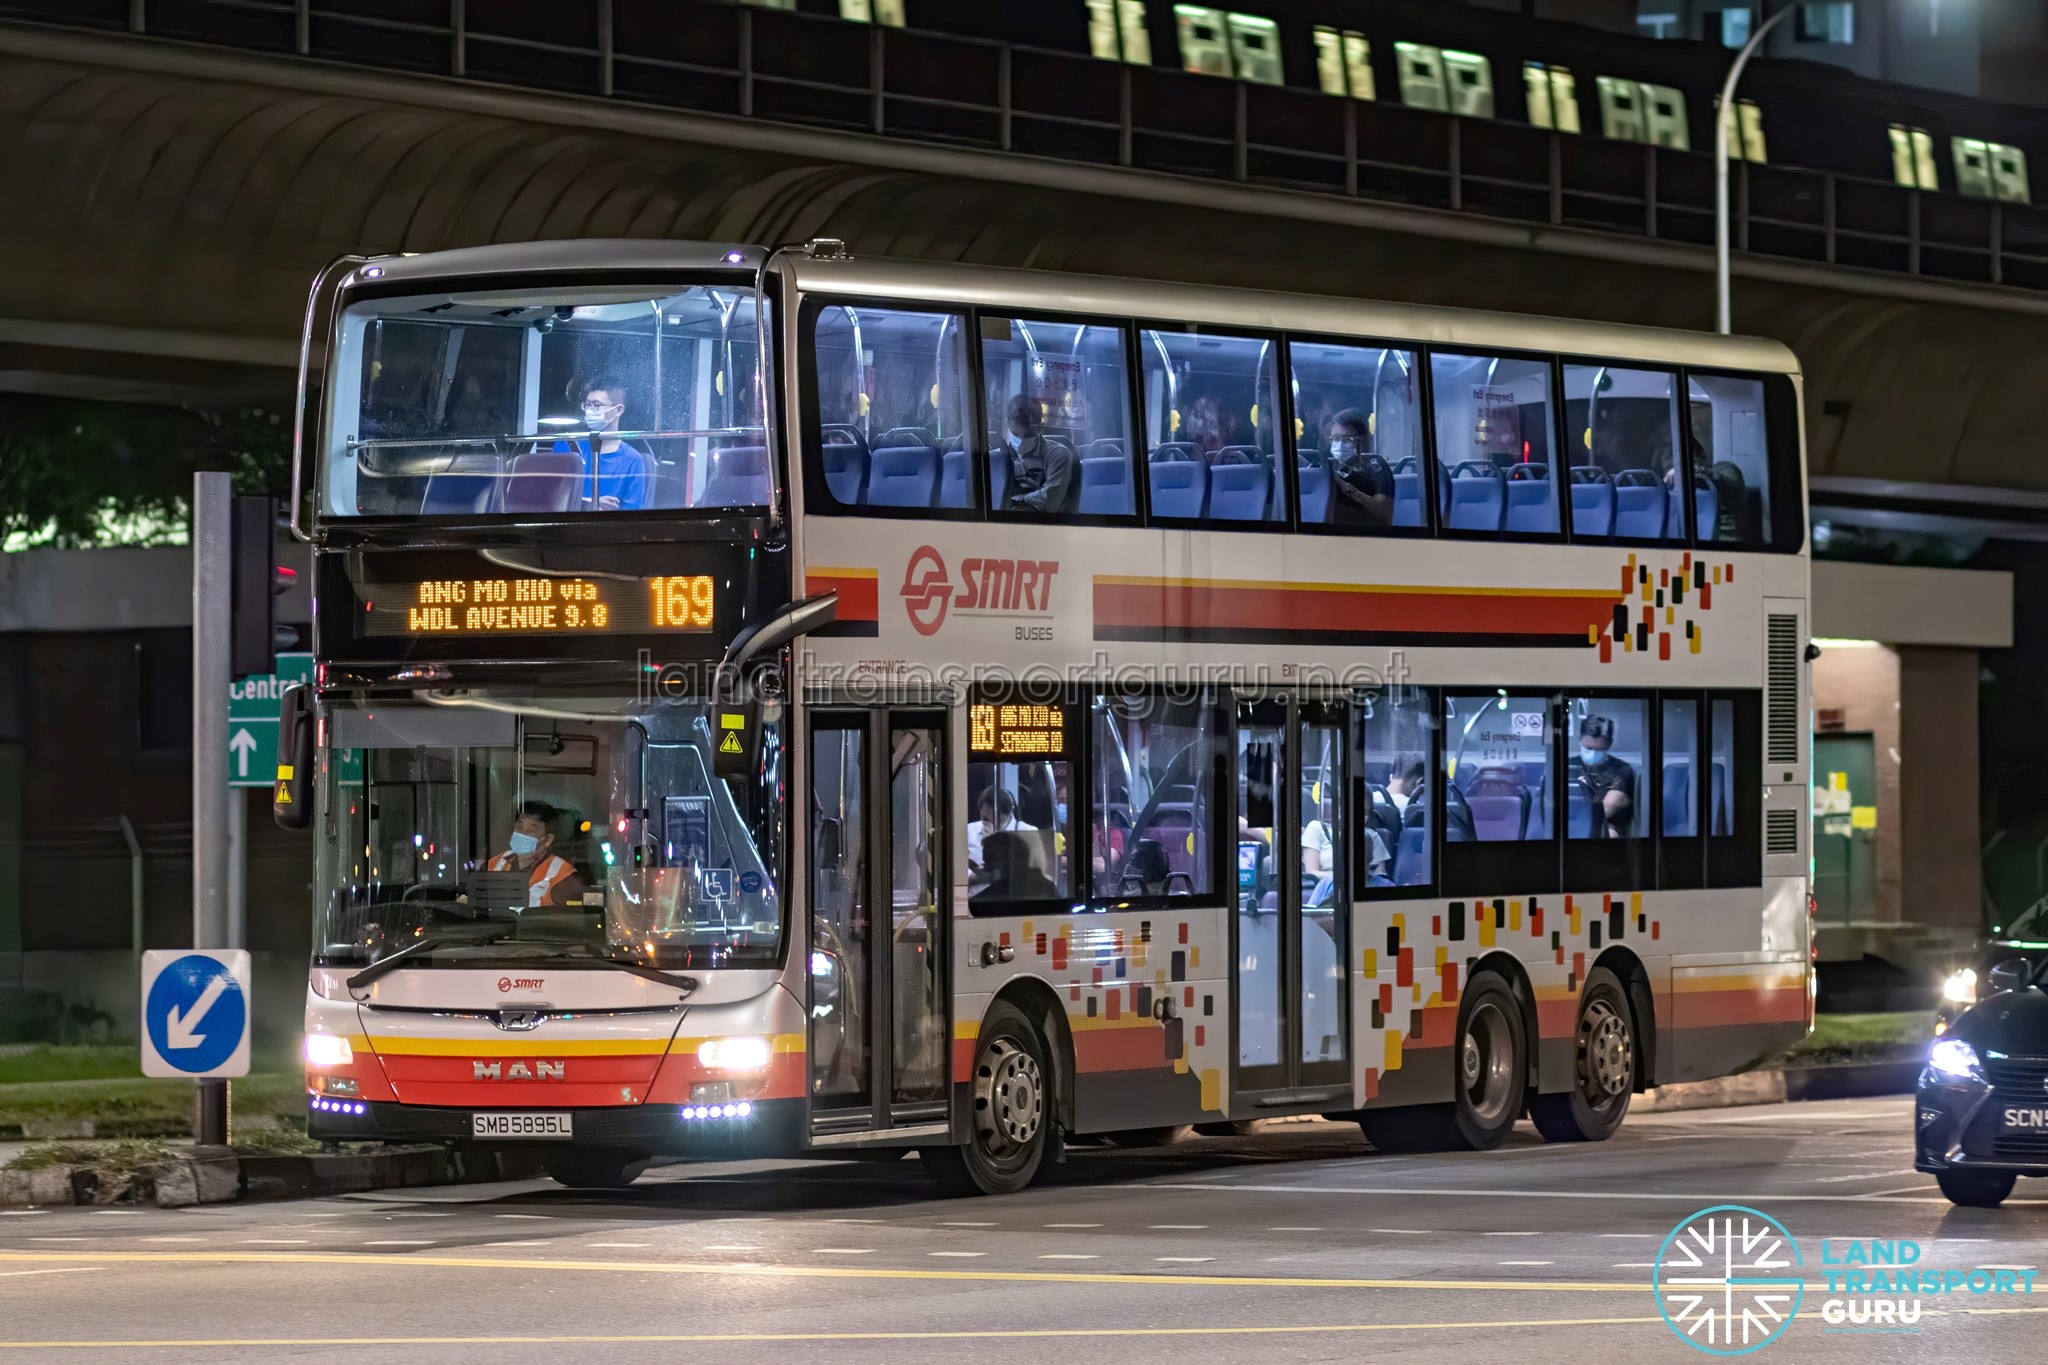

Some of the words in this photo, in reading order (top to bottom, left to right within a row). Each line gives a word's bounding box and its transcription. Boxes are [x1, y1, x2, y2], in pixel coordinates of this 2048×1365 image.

[420, 581, 466, 603] ANG
[474, 580, 507, 602] MO
[516, 579, 552, 601] KIO
[560, 578, 597, 600] via
[954, 558, 1059, 610] SMRT
[651, 575, 714, 626] 169
[410, 607, 458, 630] WDL
[466, 605, 557, 629] AVENUE
[1014, 626, 1053, 640] BUSES
[858, 660, 906, 674] ENTRANCE
[230, 673, 307, 700] Centr
[513, 979, 545, 989] SMRT
[473, 1061, 565, 1080] MAN
